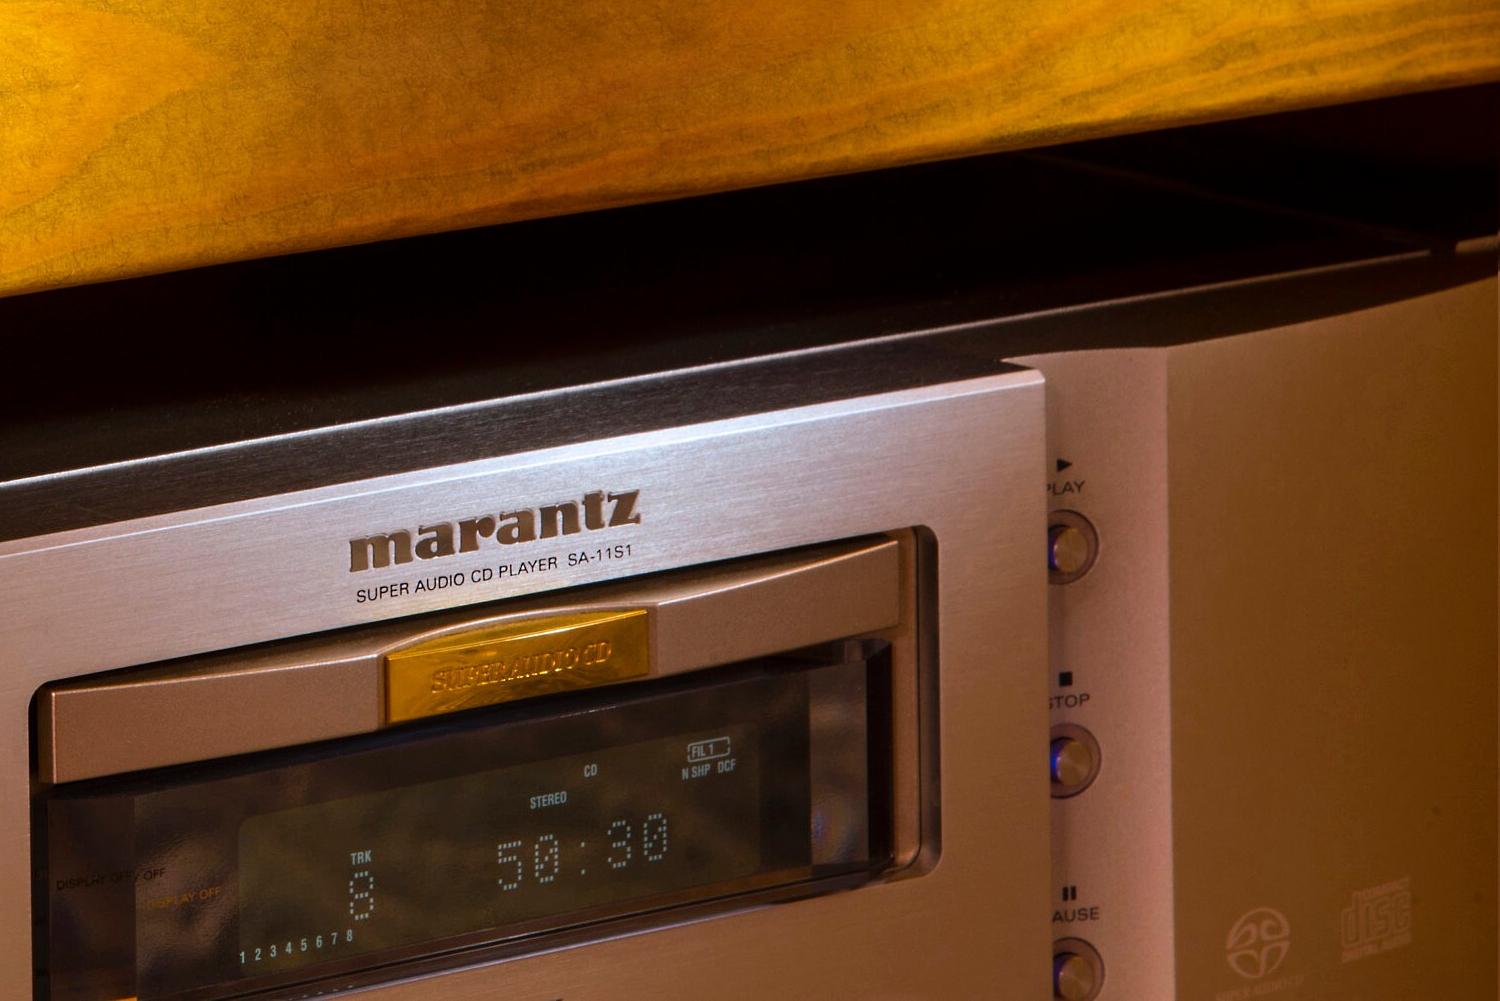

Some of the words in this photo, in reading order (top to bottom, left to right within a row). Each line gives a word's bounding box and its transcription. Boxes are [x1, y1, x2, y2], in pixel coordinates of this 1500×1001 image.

[349, 489, 642, 574] marantz
[356, 582, 410, 604] SUPER
[414, 573, 466, 594] AUDIO
[470, 567, 494, 583] CD
[498, 556, 559, 579] PLAYER
[567, 543, 633, 568] SA-11S1
[431, 662, 502, 694] SUPER
[503, 646, 579, 682] AUDIO
[580, 640, 613, 666] CD
[583, 763, 598, 779] CD
[717, 758, 737, 775] DCF
[529, 790, 568, 810] STEREO
[350, 849, 373, 867] TRK
[349, 870, 375, 922] 8
[1051, 905, 1102, 924] AUSE
